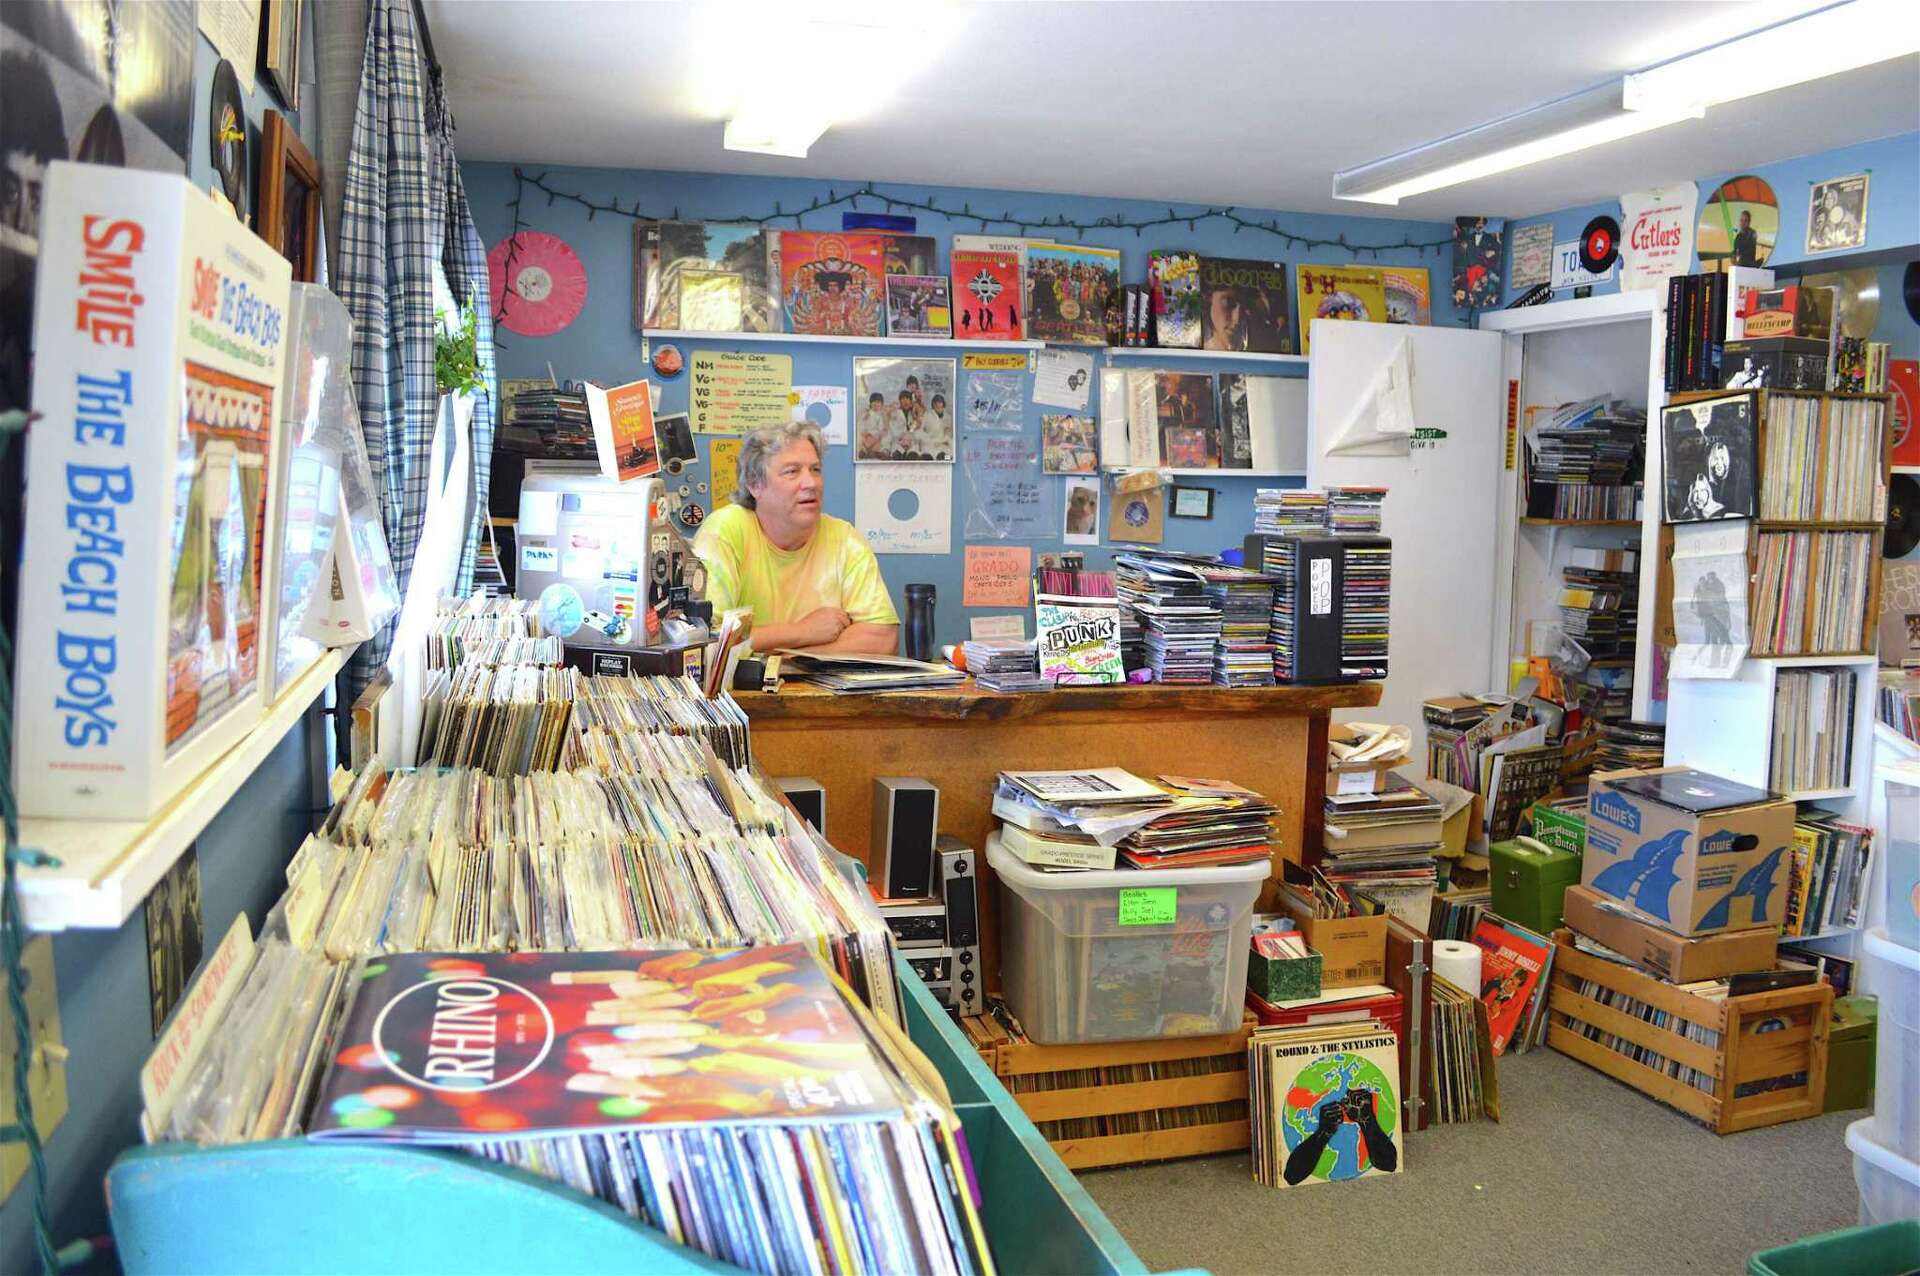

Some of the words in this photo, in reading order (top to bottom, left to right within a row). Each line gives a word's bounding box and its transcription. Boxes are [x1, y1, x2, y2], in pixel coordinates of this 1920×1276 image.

[1631, 216, 1681, 251] Cutler's
[695, 360, 714, 371] NM
[695, 387, 710, 397] VG
[75, 369, 134, 448] THE
[698, 413, 707, 422] G
[60, 461, 134, 617] BEACH
[972, 560, 1020, 574] GRADO
[1049, 620, 1112, 651] PUNK
[55, 628, 118, 749] BOYS
[1594, 798, 1637, 831] LOWE'S
[1702, 837, 1734, 852] LOWE
[1054, 857, 1072, 865] MODEL
[422, 981, 501, 1081] RHINO
[1275, 1046, 1309, 1058] ROUND
[1320, 1042, 1341, 1053] THE
[1341, 1036, 1395, 1051] STYLISTICS
